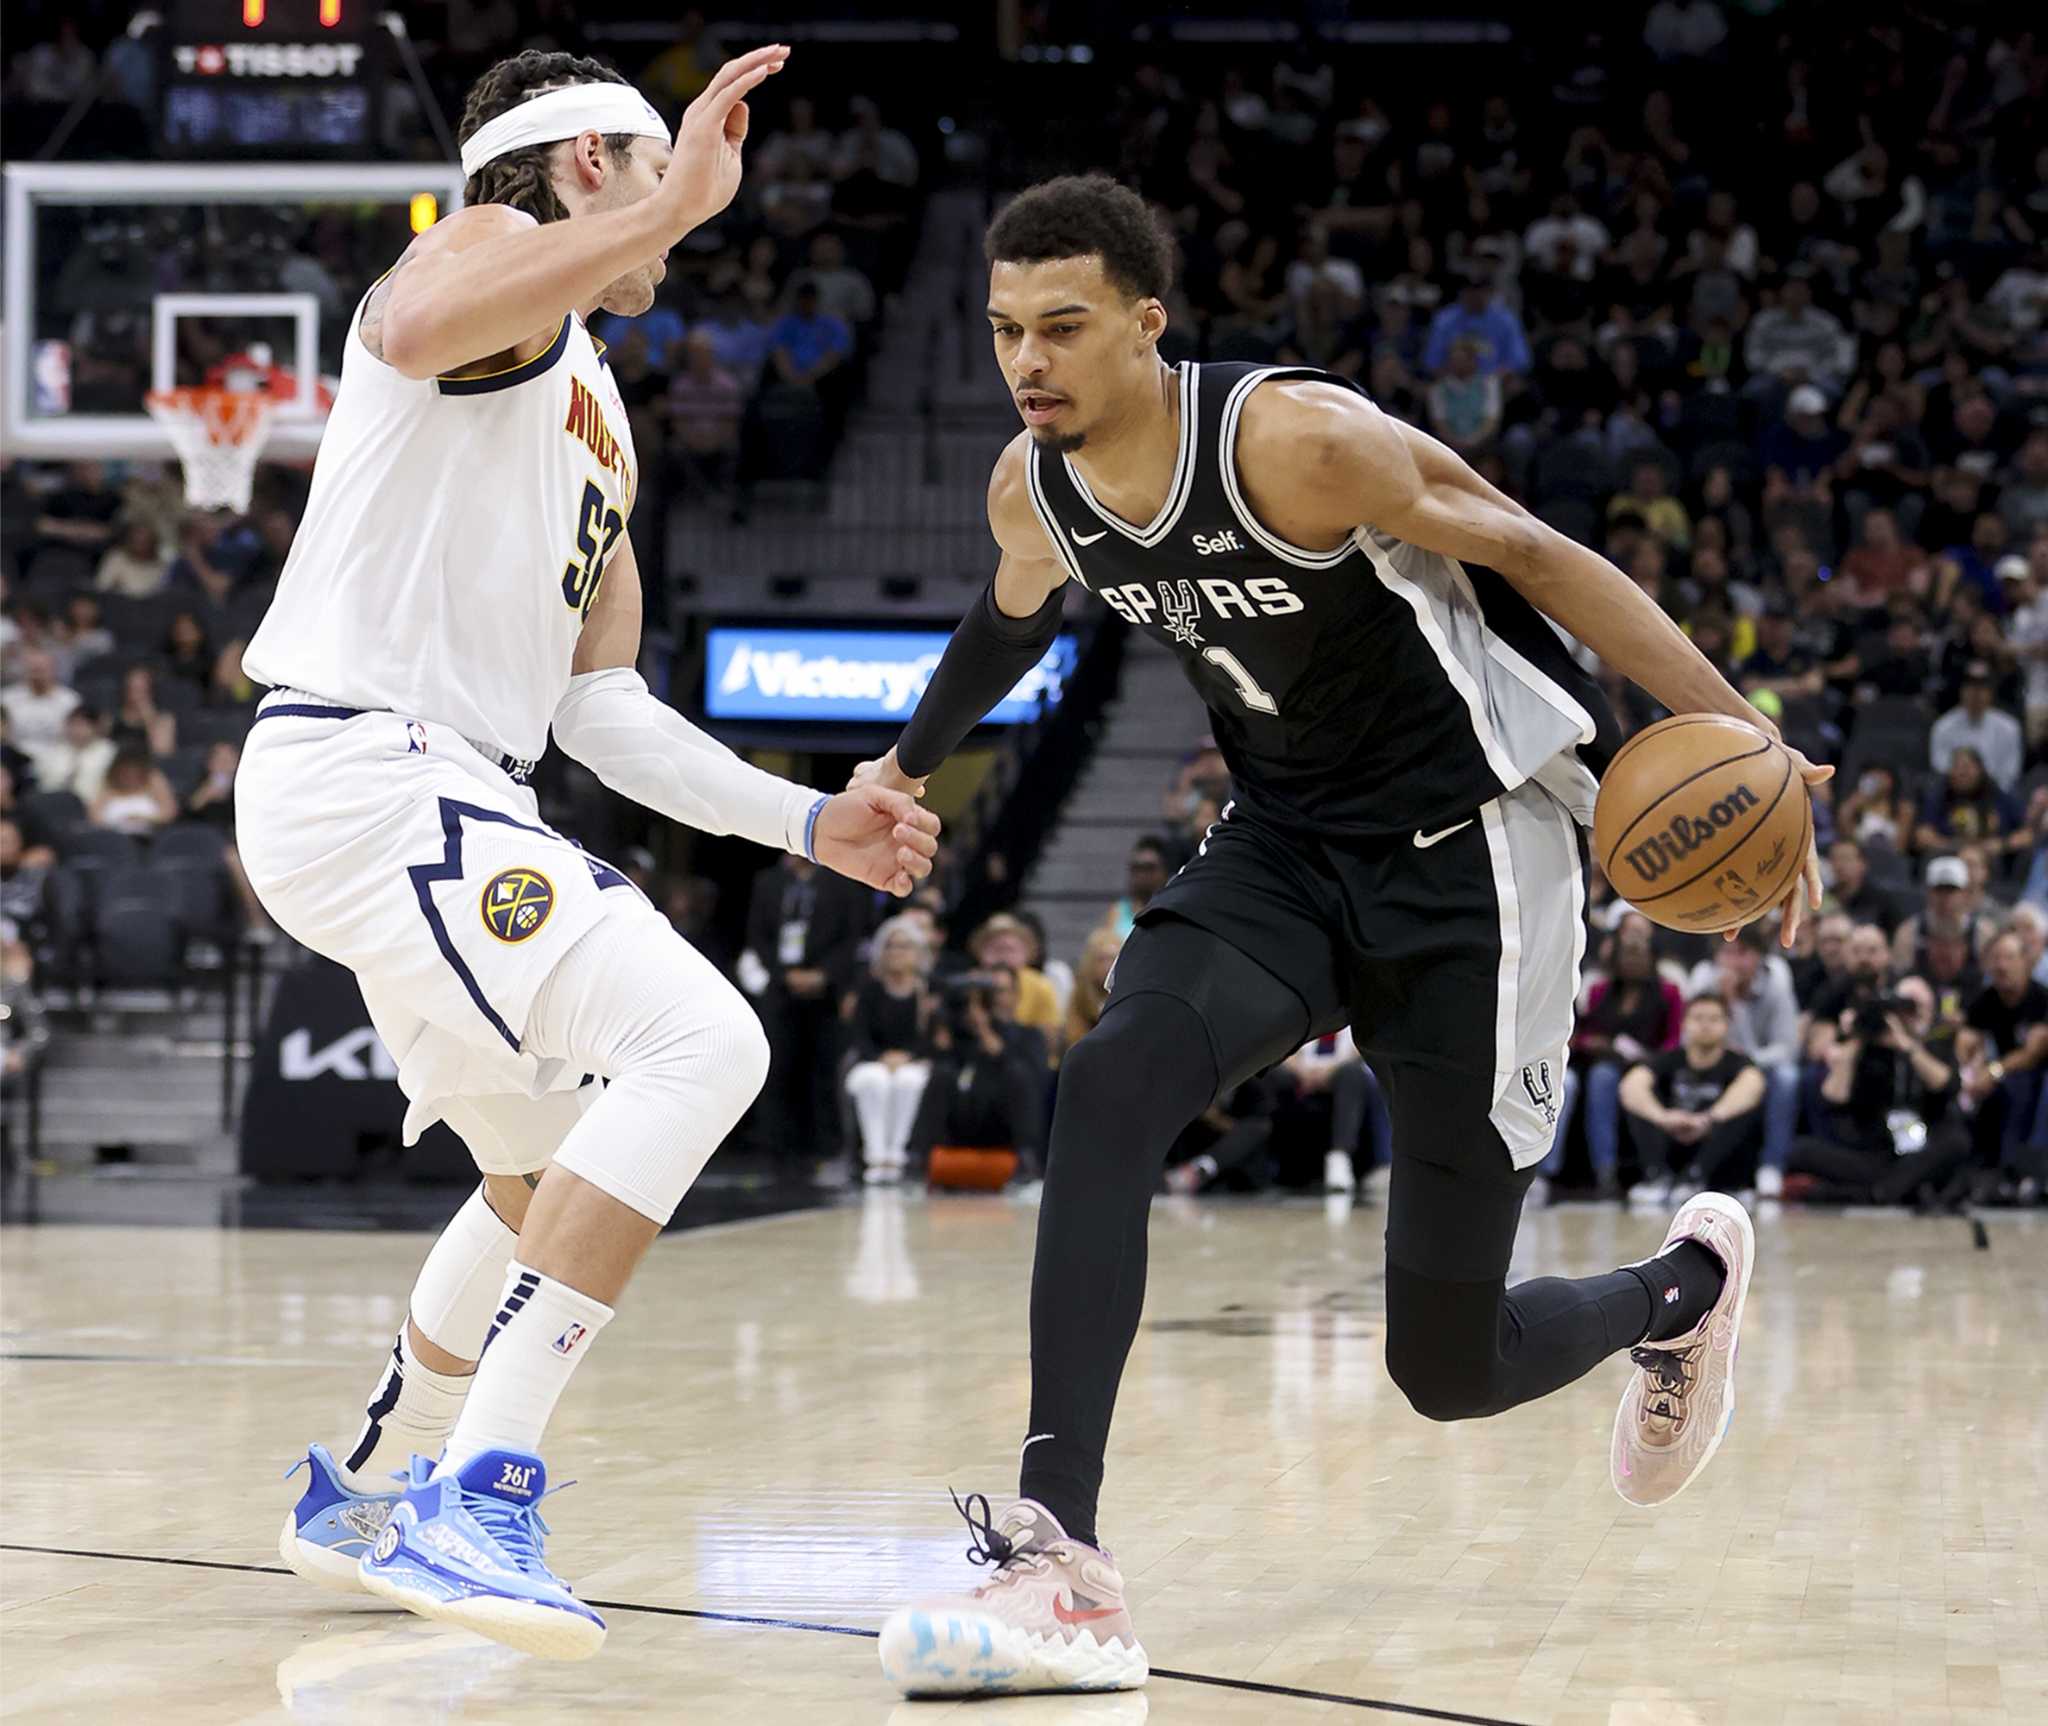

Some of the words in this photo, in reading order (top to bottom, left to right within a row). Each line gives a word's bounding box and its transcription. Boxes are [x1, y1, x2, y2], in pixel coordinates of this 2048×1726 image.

[225, 43, 362, 77] TISSOT
[1192, 530, 1245, 556] Self.
[1099, 577, 1304, 649] SPURS
[1202, 646, 1279, 716] 1
[1624, 783, 1761, 883] Wilson
[280, 1026, 399, 1080] KI
